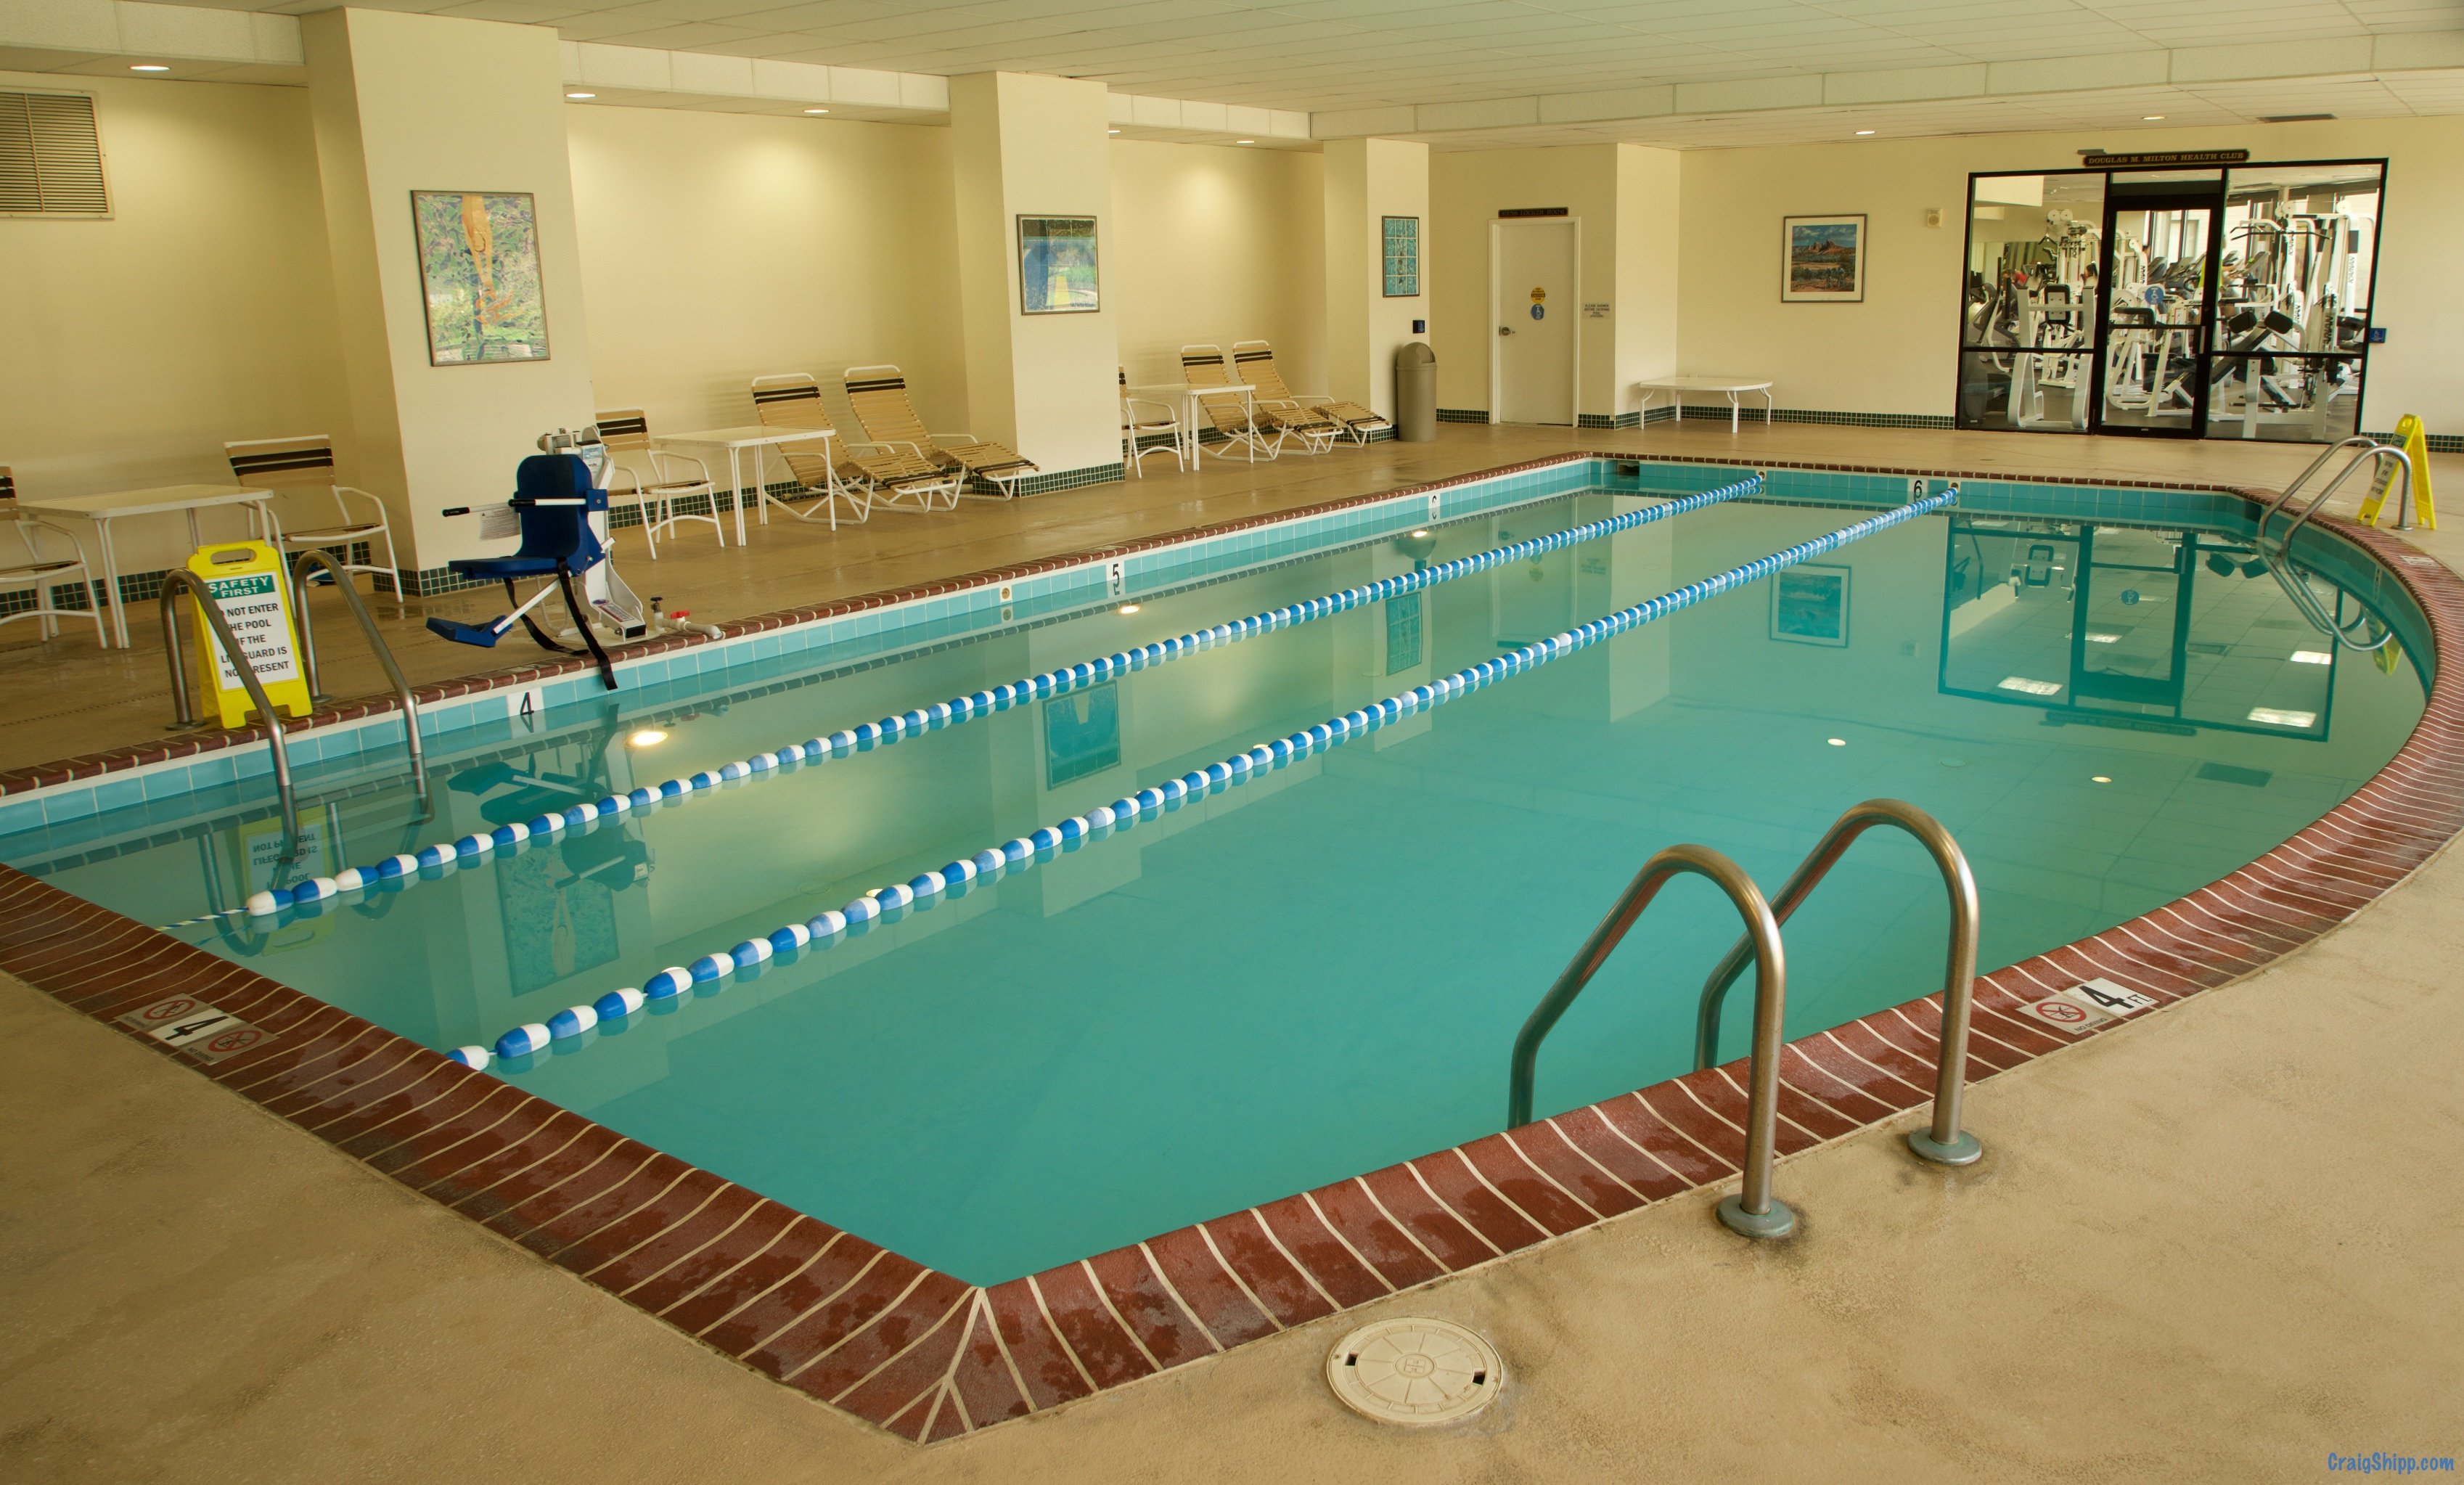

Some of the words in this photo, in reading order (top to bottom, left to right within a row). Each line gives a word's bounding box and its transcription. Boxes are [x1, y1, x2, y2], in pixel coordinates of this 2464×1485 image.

[1914, 480, 1922, 494] 6
[1113, 563, 1119, 581] 5
[208, 576, 269, 593] SAFETY
[221, 586, 259, 597] FIRST
[226, 607, 245, 617] NOT
[248, 603, 279, 614] ENTER
[229, 622, 244, 631] HE
[245, 619, 271, 629] POOL
[247, 634, 266, 645] THE
[224, 668, 239, 678] NO
[253, 661, 289, 674] RESENT
[520, 692, 534, 715] 4
[2079, 986, 2134, 1009] 4
[165, 1016, 229, 1041] 4
